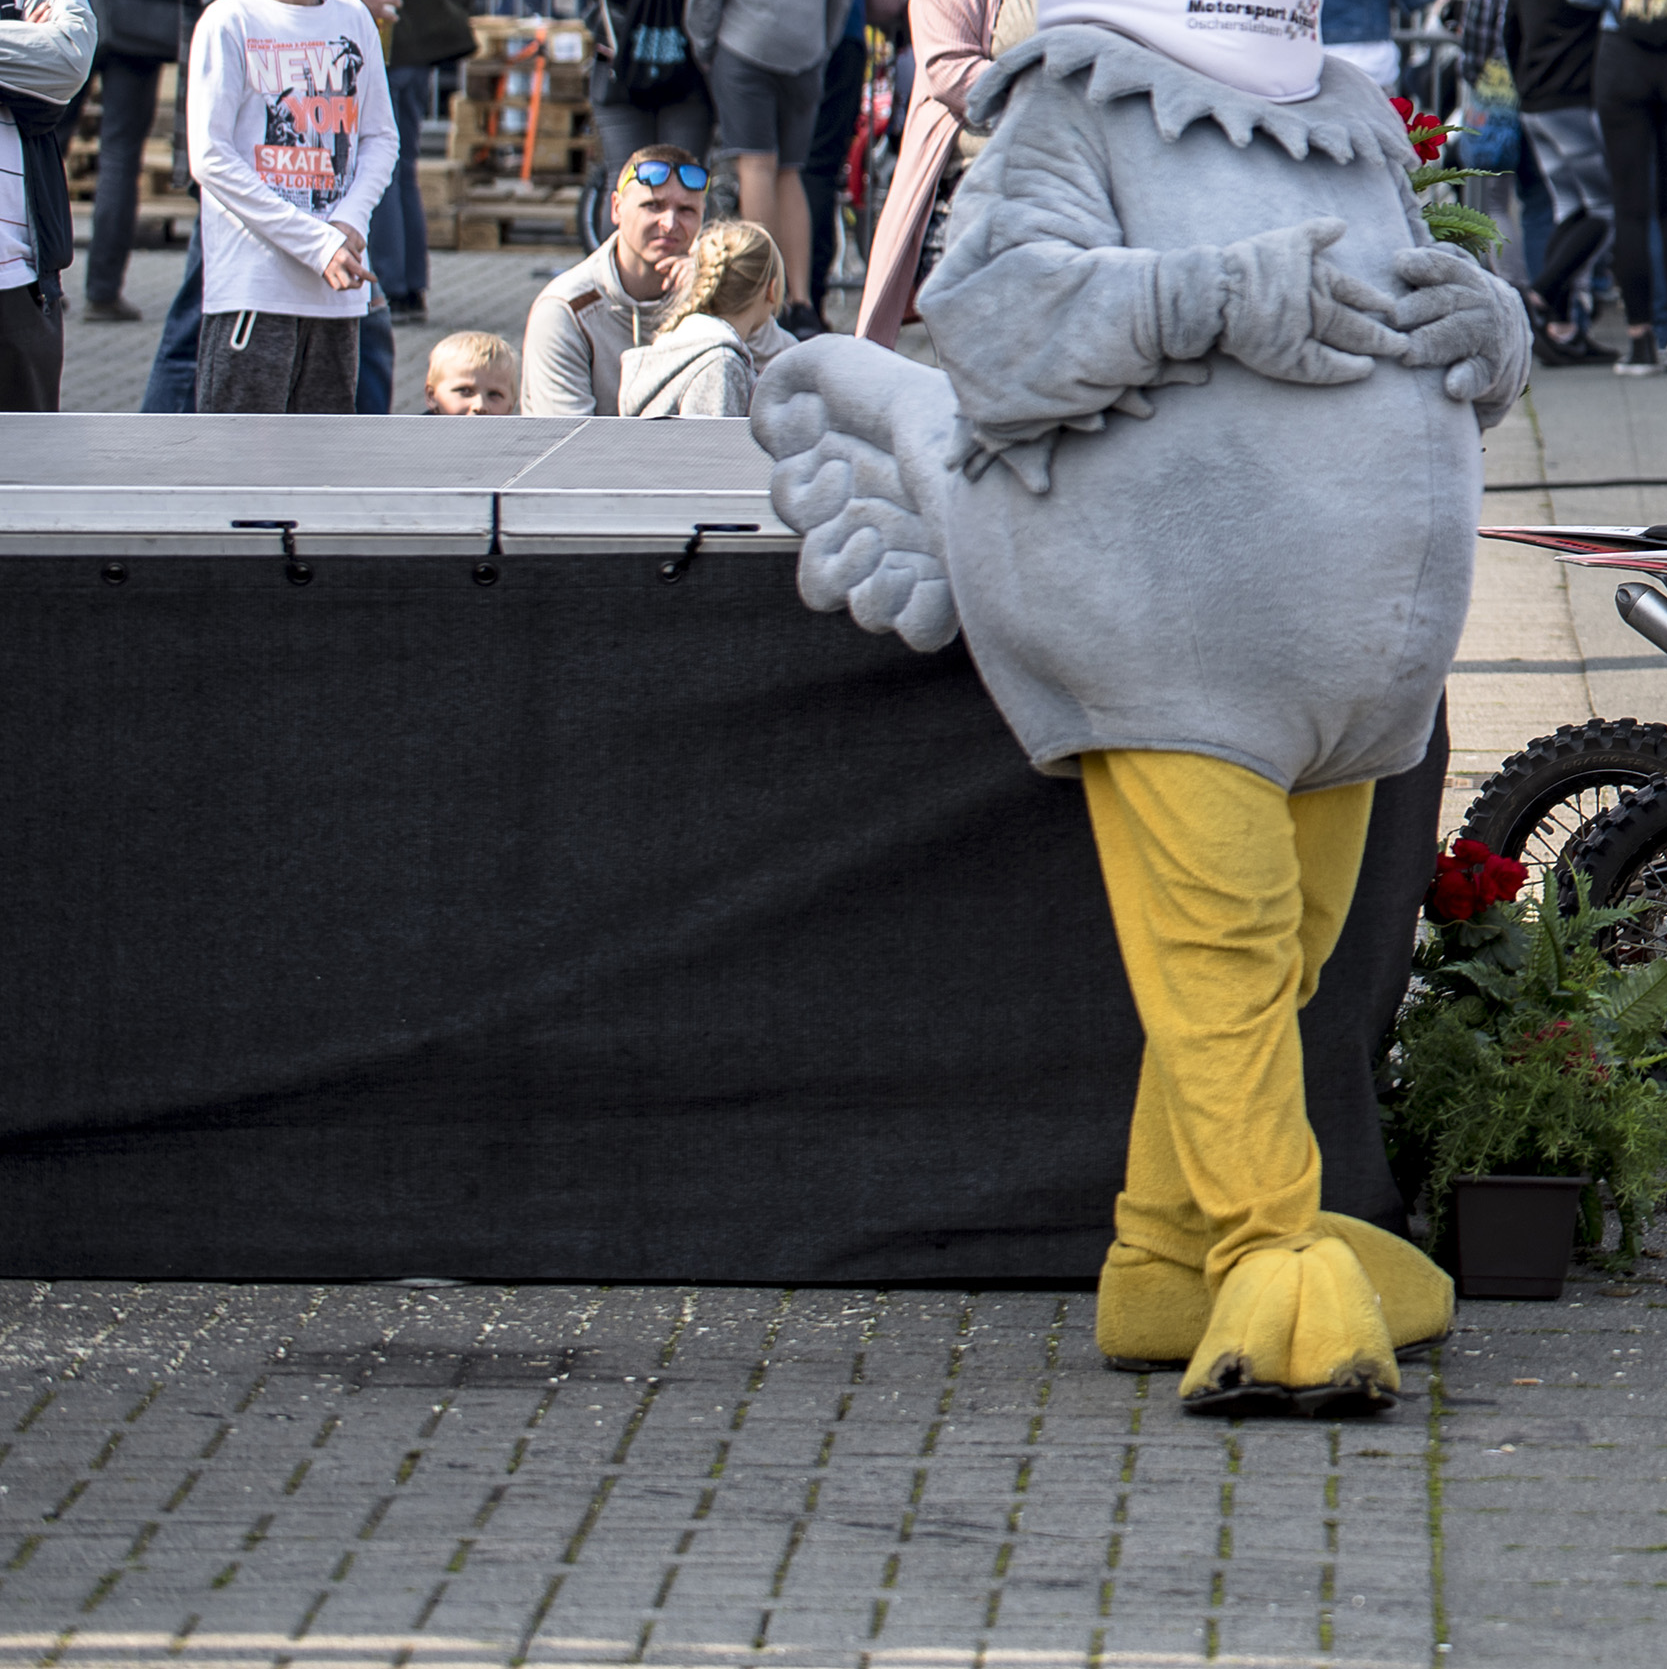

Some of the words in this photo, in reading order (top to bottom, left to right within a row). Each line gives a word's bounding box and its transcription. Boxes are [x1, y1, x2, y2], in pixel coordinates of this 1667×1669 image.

[1187, 0, 1288, 21] Motorsport
[1185, 17, 1284, 37] Oschersleben
[247, 47, 348, 94] NEW
[260, 147, 334, 173] SKATE
